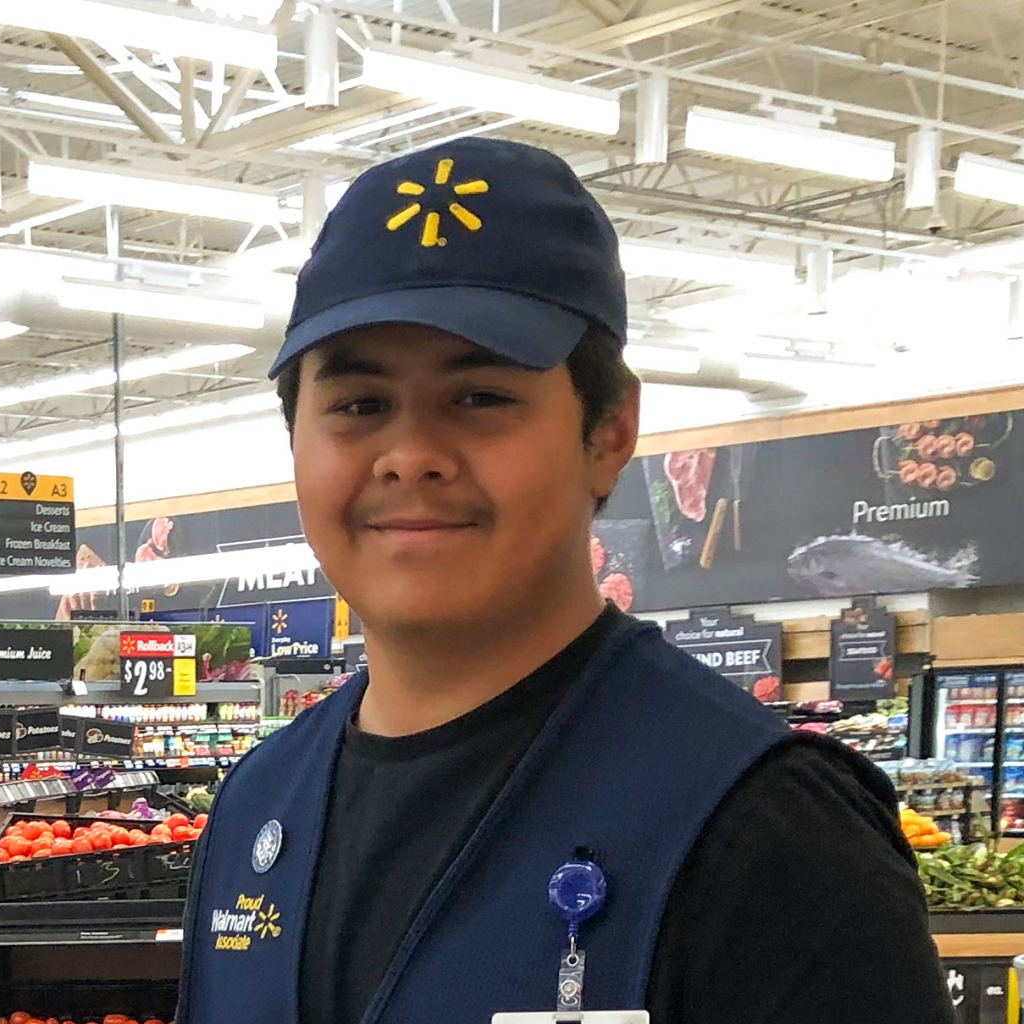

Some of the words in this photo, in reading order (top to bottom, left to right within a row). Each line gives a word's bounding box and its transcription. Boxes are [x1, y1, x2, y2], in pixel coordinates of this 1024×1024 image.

[51, 484, 68, 498] A3
[36, 504, 71, 516] Desserts
[853, 496, 950, 524] Premium
[31, 521, 43, 533] Ice
[44, 522, 71, 533] Cream
[5, 538, 33, 550] Frozen
[34, 539, 71, 551] Breakfast
[6, 556, 34, 567] Cream
[34, 557, 71, 568] Novelties
[27, 646, 52, 660] Juice
[725, 649, 761, 667] BEEF
[27, 725, 59, 735] Potatoes
[103, 734, 132, 745] Potatoes
[235, 894, 265, 910] Proud
[210, 909, 256, 932] Walmart
